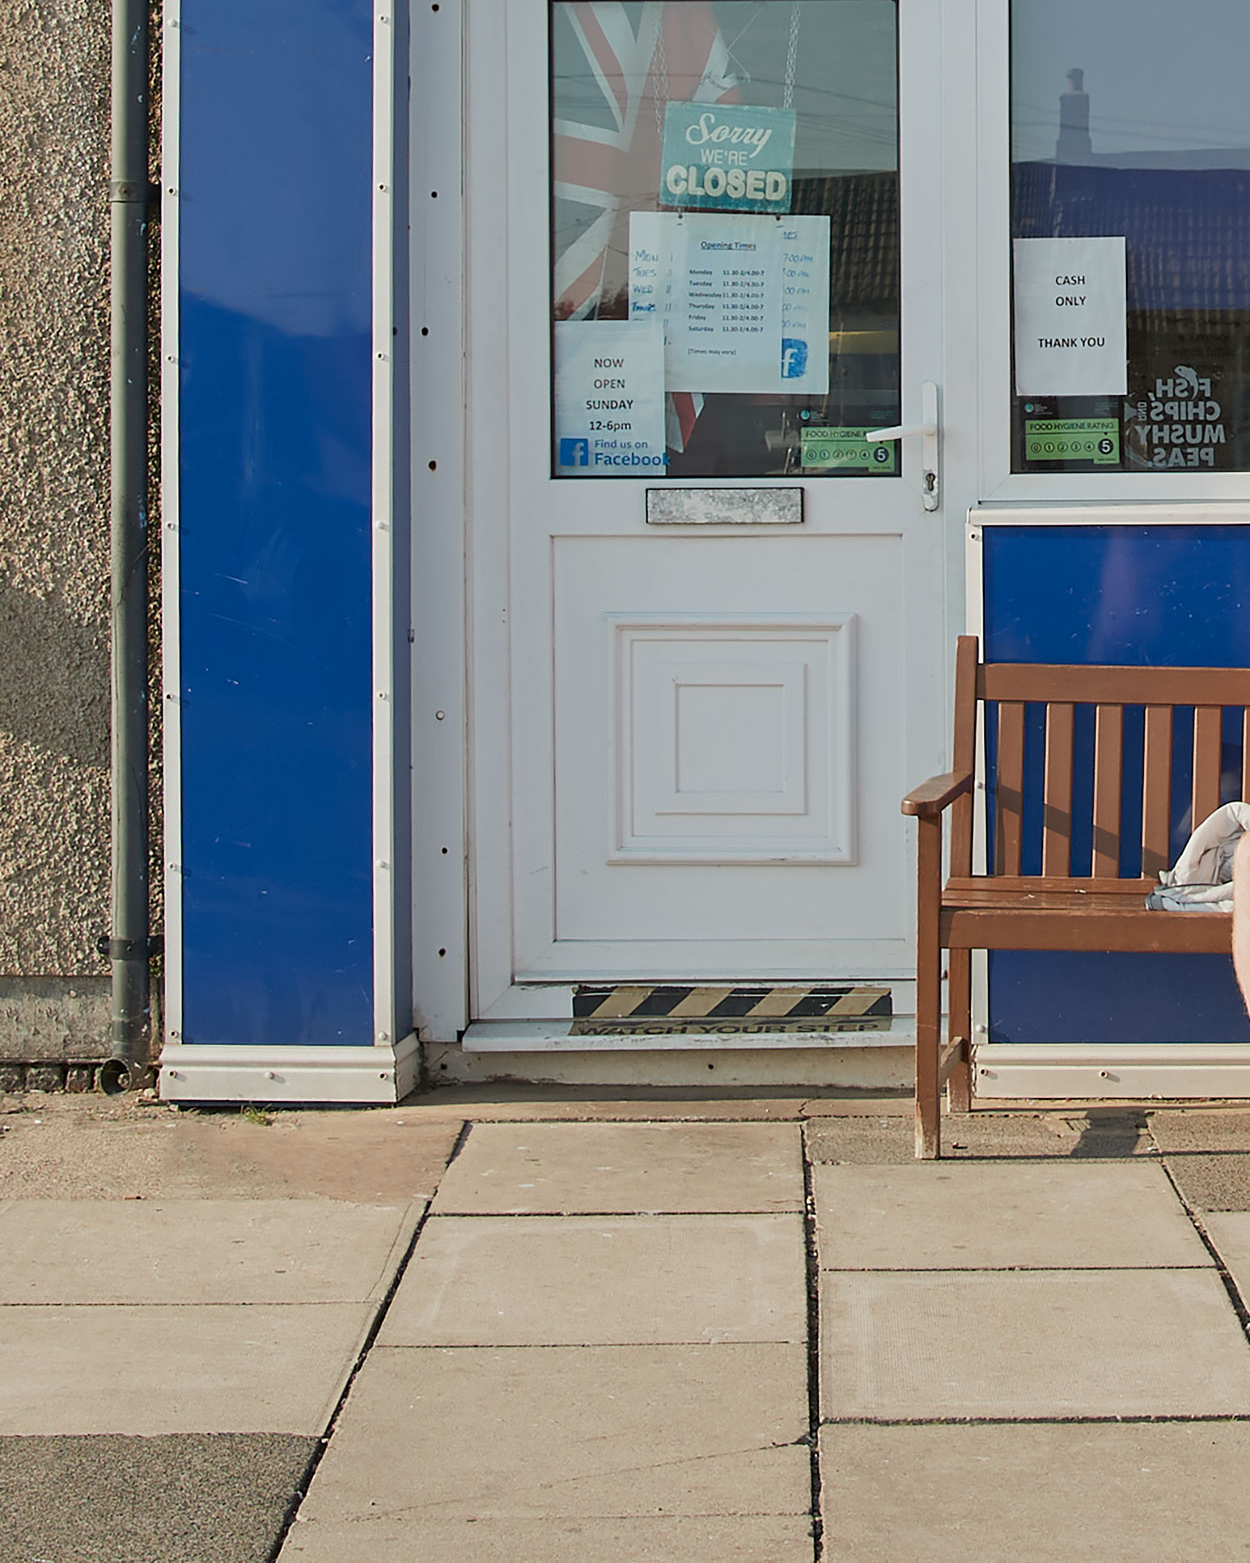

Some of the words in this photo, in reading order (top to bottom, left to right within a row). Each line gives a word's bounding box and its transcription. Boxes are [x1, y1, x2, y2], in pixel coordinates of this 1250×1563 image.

[685, 113, 773, 159] Sorry
[700, 149, 748, 166] WE'RE
[666, 165, 787, 200] CLOSED
[701, 241, 732, 250] Opening
[734, 241, 756, 249] Times
[1055, 276, 1085, 286] CASH
[1055, 296, 1086, 306] ONLY
[1038, 338, 1077, 348] THANK
[1080, 337, 1105, 348] YOU
[594, 358, 624, 368] NOW
[593, 379, 625, 389] OPEN
[586, 400, 634, 410] SUNDAY
[589, 421, 632, 432] 12-6pm
[1054, 422, 1085, 430] HYGIENE
[1087, 421, 1114, 429] RATING
[594, 439, 617, 449] Find
[620, 441, 632, 449] us
[635, 441, 648, 449] on
[1102, 441, 1110, 452] 5
[594, 452, 671, 466] Facebook
[877, 449, 886, 461] 5
[579, 1025, 687, 1036] WATCH
[698, 1025, 787, 1035] YOUR
[796, 1024, 879, 1033] STEP
